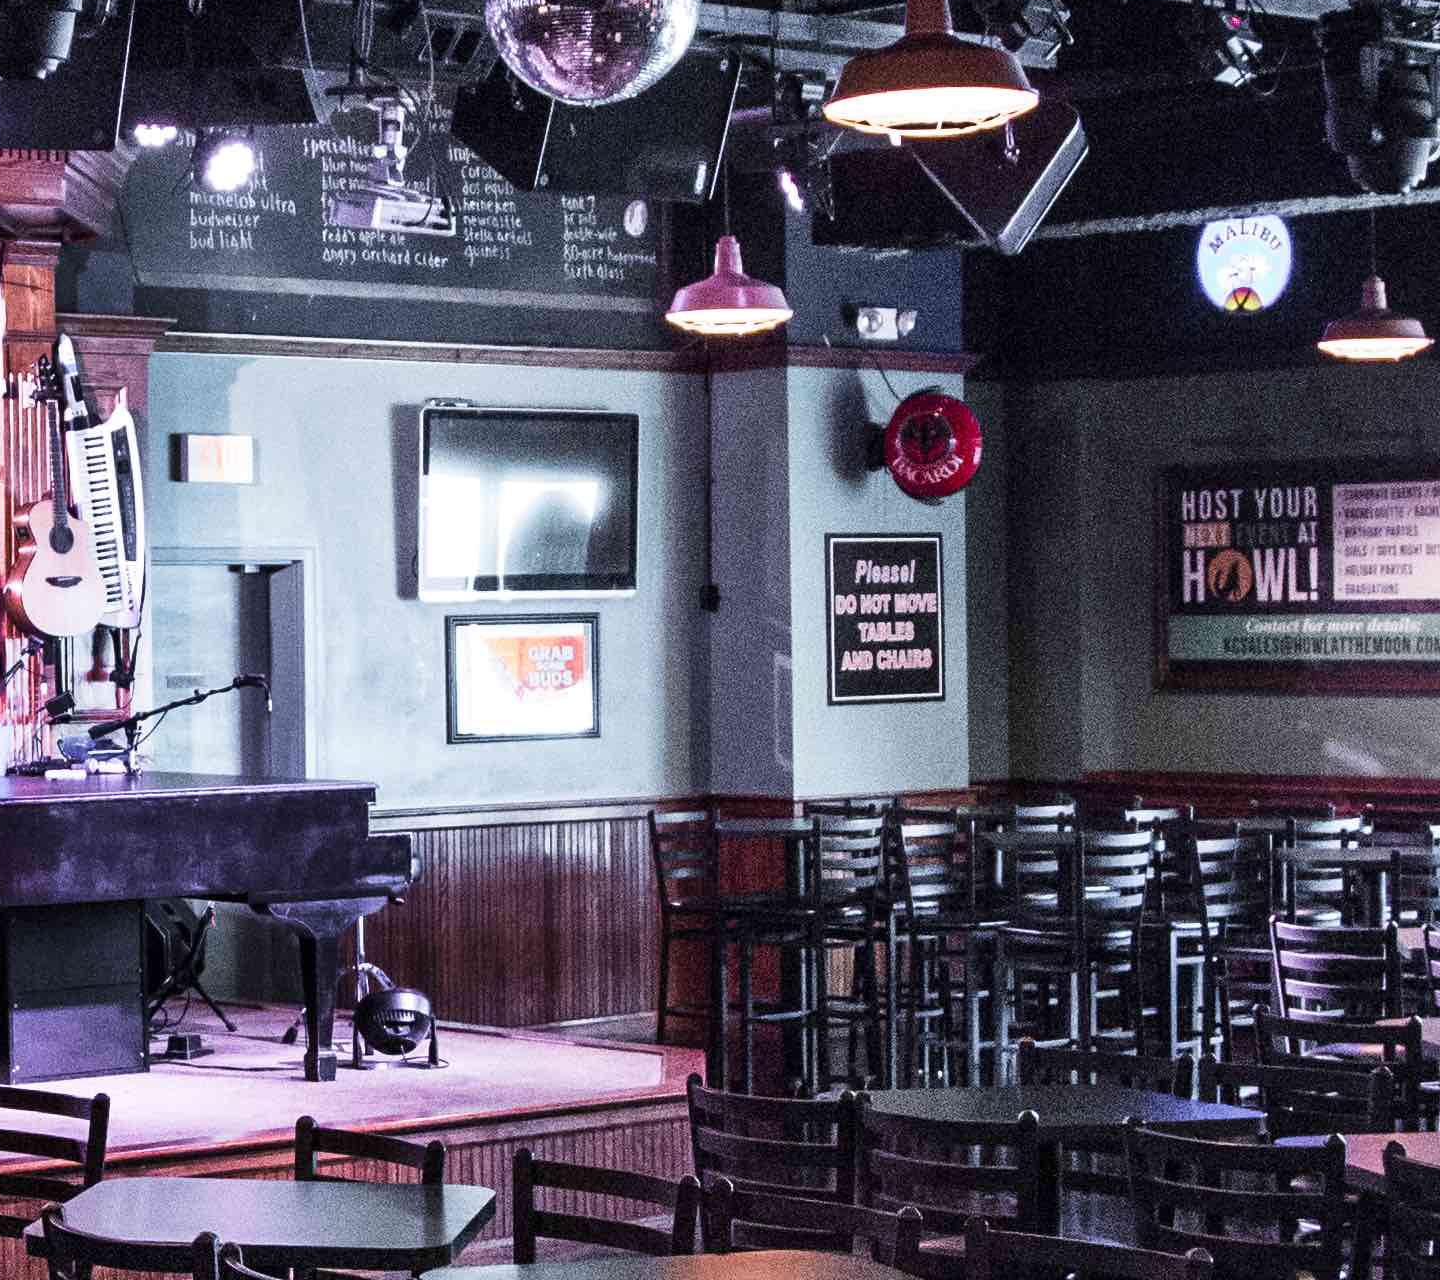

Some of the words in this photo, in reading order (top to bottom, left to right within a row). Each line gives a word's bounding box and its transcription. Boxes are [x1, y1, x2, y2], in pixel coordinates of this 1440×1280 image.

[323, 156, 347, 172] blue
[190, 192, 255, 209] michelob
[261, 197, 296, 216] ultra
[463, 198, 516, 212] heineken
[190, 209, 260, 226] budweiser
[190, 231, 214, 249] bud
[219, 231, 254, 250] light
[359, 231, 388, 247] apple
[1208, 219, 1282, 255] MALIBU
[1182, 489, 1243, 521] HOST
[1255, 486, 1317, 519] YOUR
[1297, 521, 1318, 544] AT
[855, 560, 916, 584] Please!
[1183, 547, 1319, 603] HOWL!
[835, 594, 857, 615] DO
[860, 594, 891, 615] NOT
[894, 593, 937, 613] MOVE
[858, 621, 914, 642] TABLES
[528, 645, 575, 661] GRAB
[842, 650, 874, 670] AND
[876, 649, 933, 669] CHAIRS
[528, 671, 574, 689] BUDS
